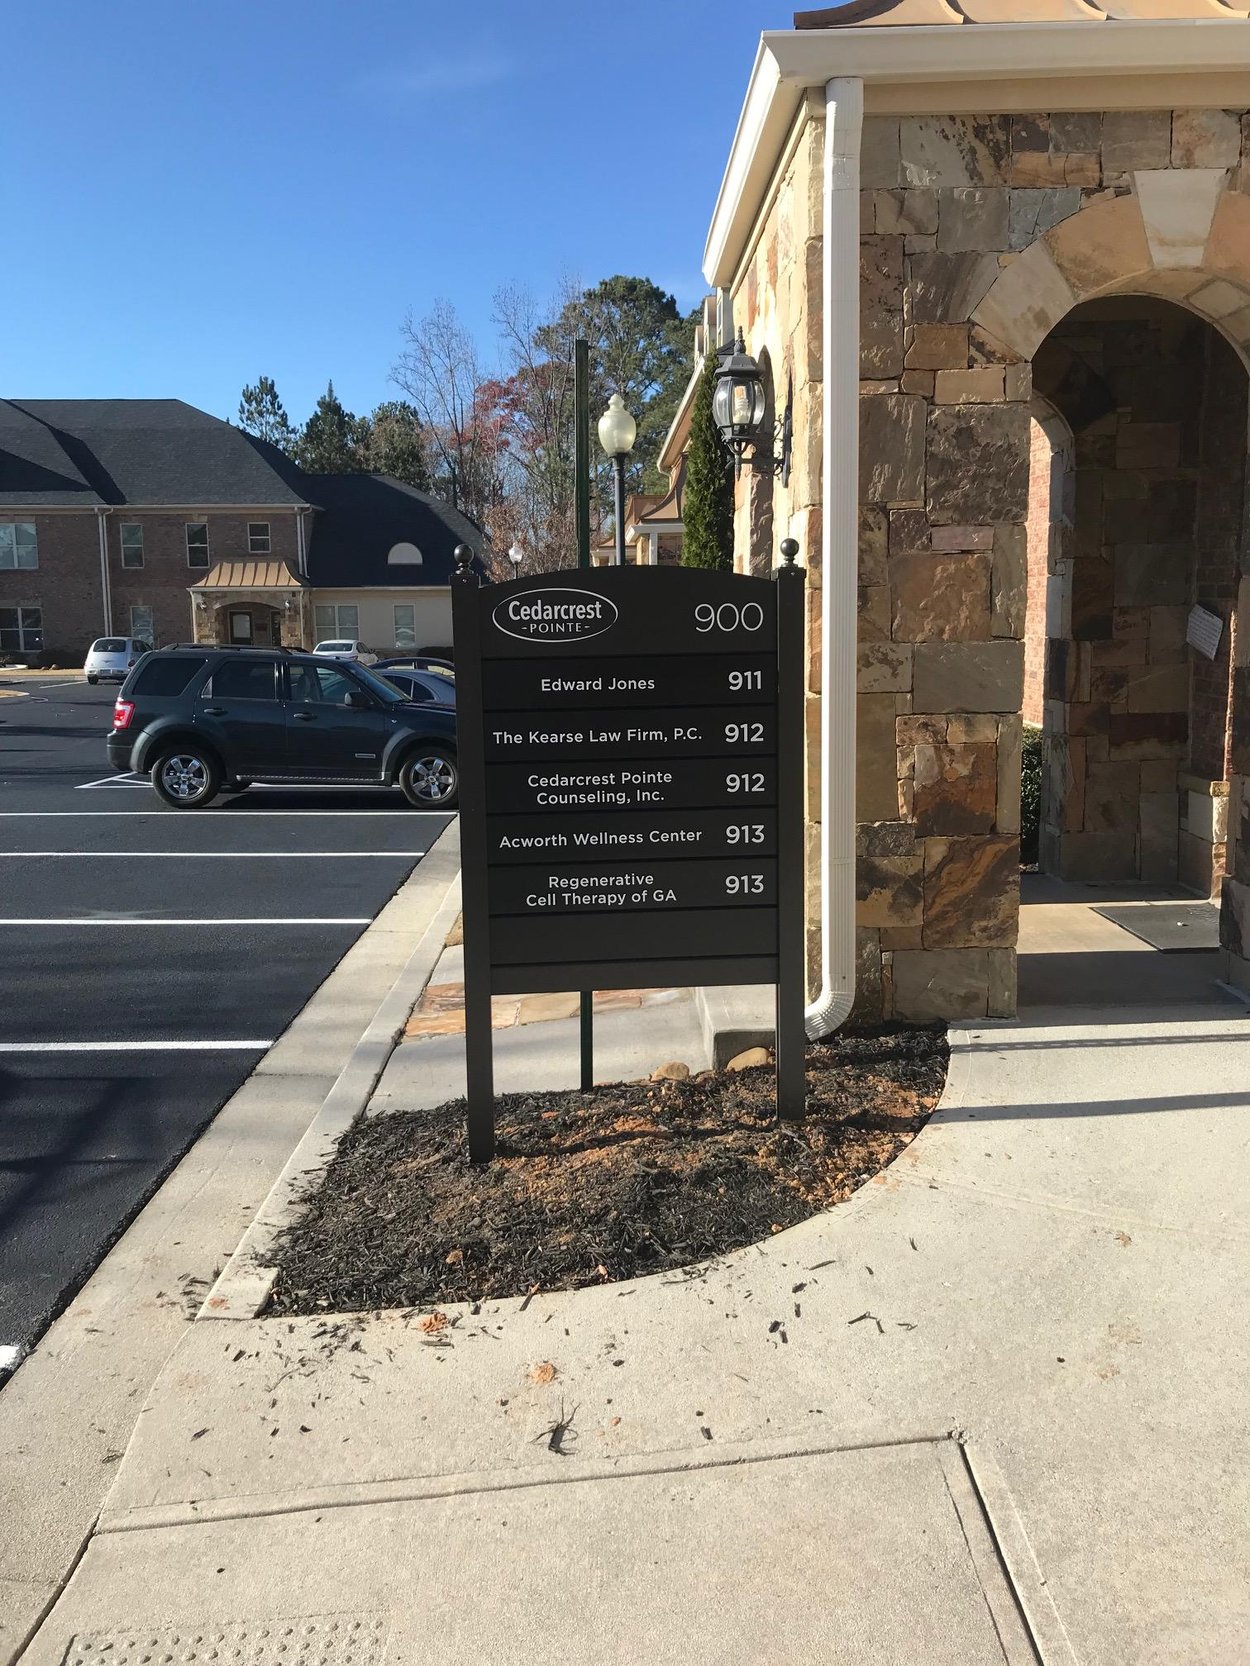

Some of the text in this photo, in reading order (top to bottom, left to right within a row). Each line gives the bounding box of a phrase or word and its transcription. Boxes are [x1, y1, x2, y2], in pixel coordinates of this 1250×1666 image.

[508, 599, 602, 621] Cedarcrest
[694, 602, 764, 633] 900
[541, 677, 655, 692] Edward Jones
[728, 670, 762, 691] 911
[493, 727, 702, 744] The Kearse Law Firm, P.C.
[724, 722, 764, 743] 912
[527, 771, 673, 788] Cedarcrest Pointe
[725, 773, 765, 793] 912
[536, 789, 665, 805] Counseling, Inc.
[499, 829, 703, 849] Acworth Wellness Center
[725, 824, 765, 845] 913
[548, 872, 654, 890] Regenerative
[725, 874, 764, 894] 913
[526, 889, 677, 907] Cell Therapy of GA
